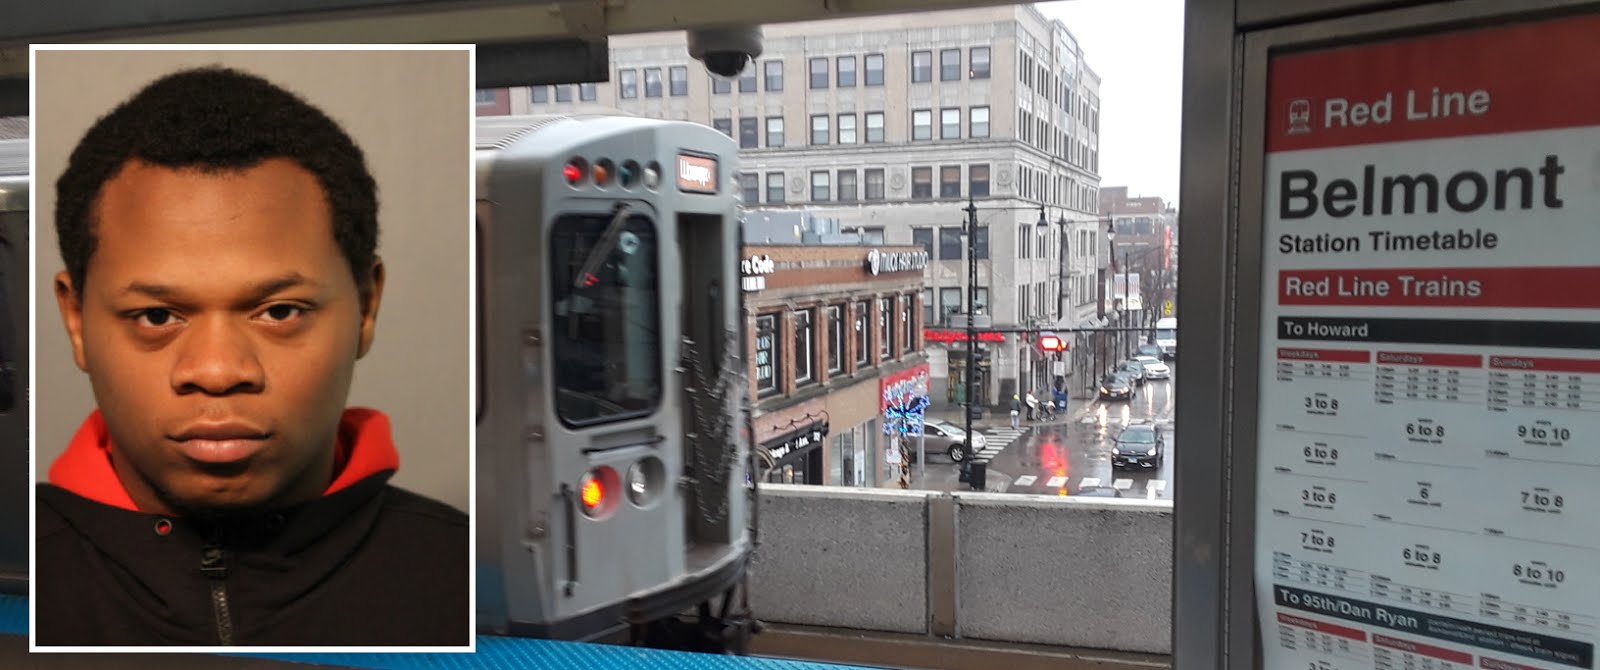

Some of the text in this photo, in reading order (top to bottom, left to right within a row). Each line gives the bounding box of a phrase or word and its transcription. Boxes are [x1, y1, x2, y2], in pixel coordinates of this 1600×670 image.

[1324, 87, 1492, 129] Red Line
[1279, 154, 1565, 220] Belmont
[1279, 228, 1499, 254] Station Timetable
[1285, 275, 1482, 297] Red Line Trains
[1283, 320, 1369, 337] To Howard
[1492, 357, 1535, 369] Sundays
[1304, 397, 1313, 408] 3
[1315, 398, 1328, 410] to
[1406, 423, 1444, 437] 6 to 8
[1517, 426, 1570, 442] 9 to 10
[1304, 446, 1312, 457] 6
[1315, 447, 1328, 459] to
[1302, 489, 1310, 501] 3
[1313, 490, 1326, 503] to
[1420, 488, 1430, 500] 6
[1520, 491, 1564, 508] 7 to 8
[1301, 532, 1309, 544] 7
[1311, 533, 1325, 546] to
[1403, 548, 1441, 564] 6 to 8
[1526, 565, 1542, 580] to
[1547, 569, 1565, 584] 10
[1280, 589, 1419, 629] To 95th/Dan Ryan
